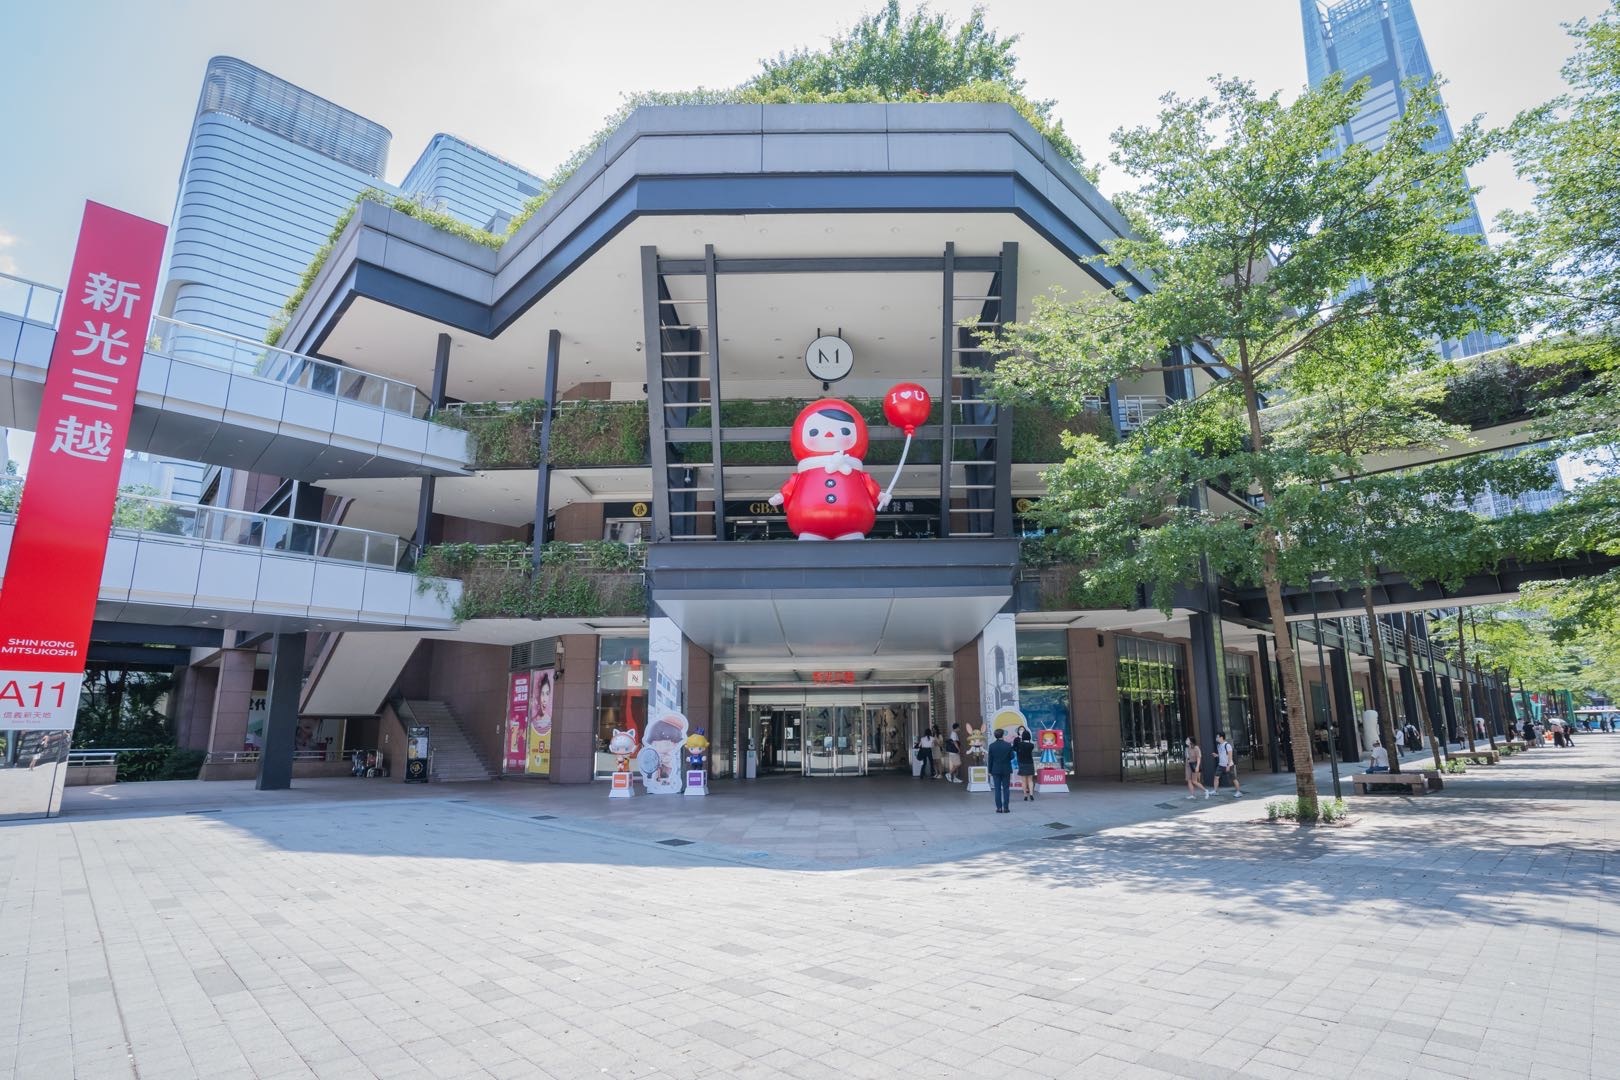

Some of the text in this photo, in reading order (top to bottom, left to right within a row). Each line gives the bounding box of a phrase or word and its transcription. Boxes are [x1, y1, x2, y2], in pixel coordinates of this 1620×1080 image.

[50, 272, 141, 462] 新光三越
[891, 390, 925, 405] I U
[8, 638, 75, 648] SHIN KONG
[1, 646, 78, 656] MITSUKOSHI
[0, 680, 65, 707] A11
